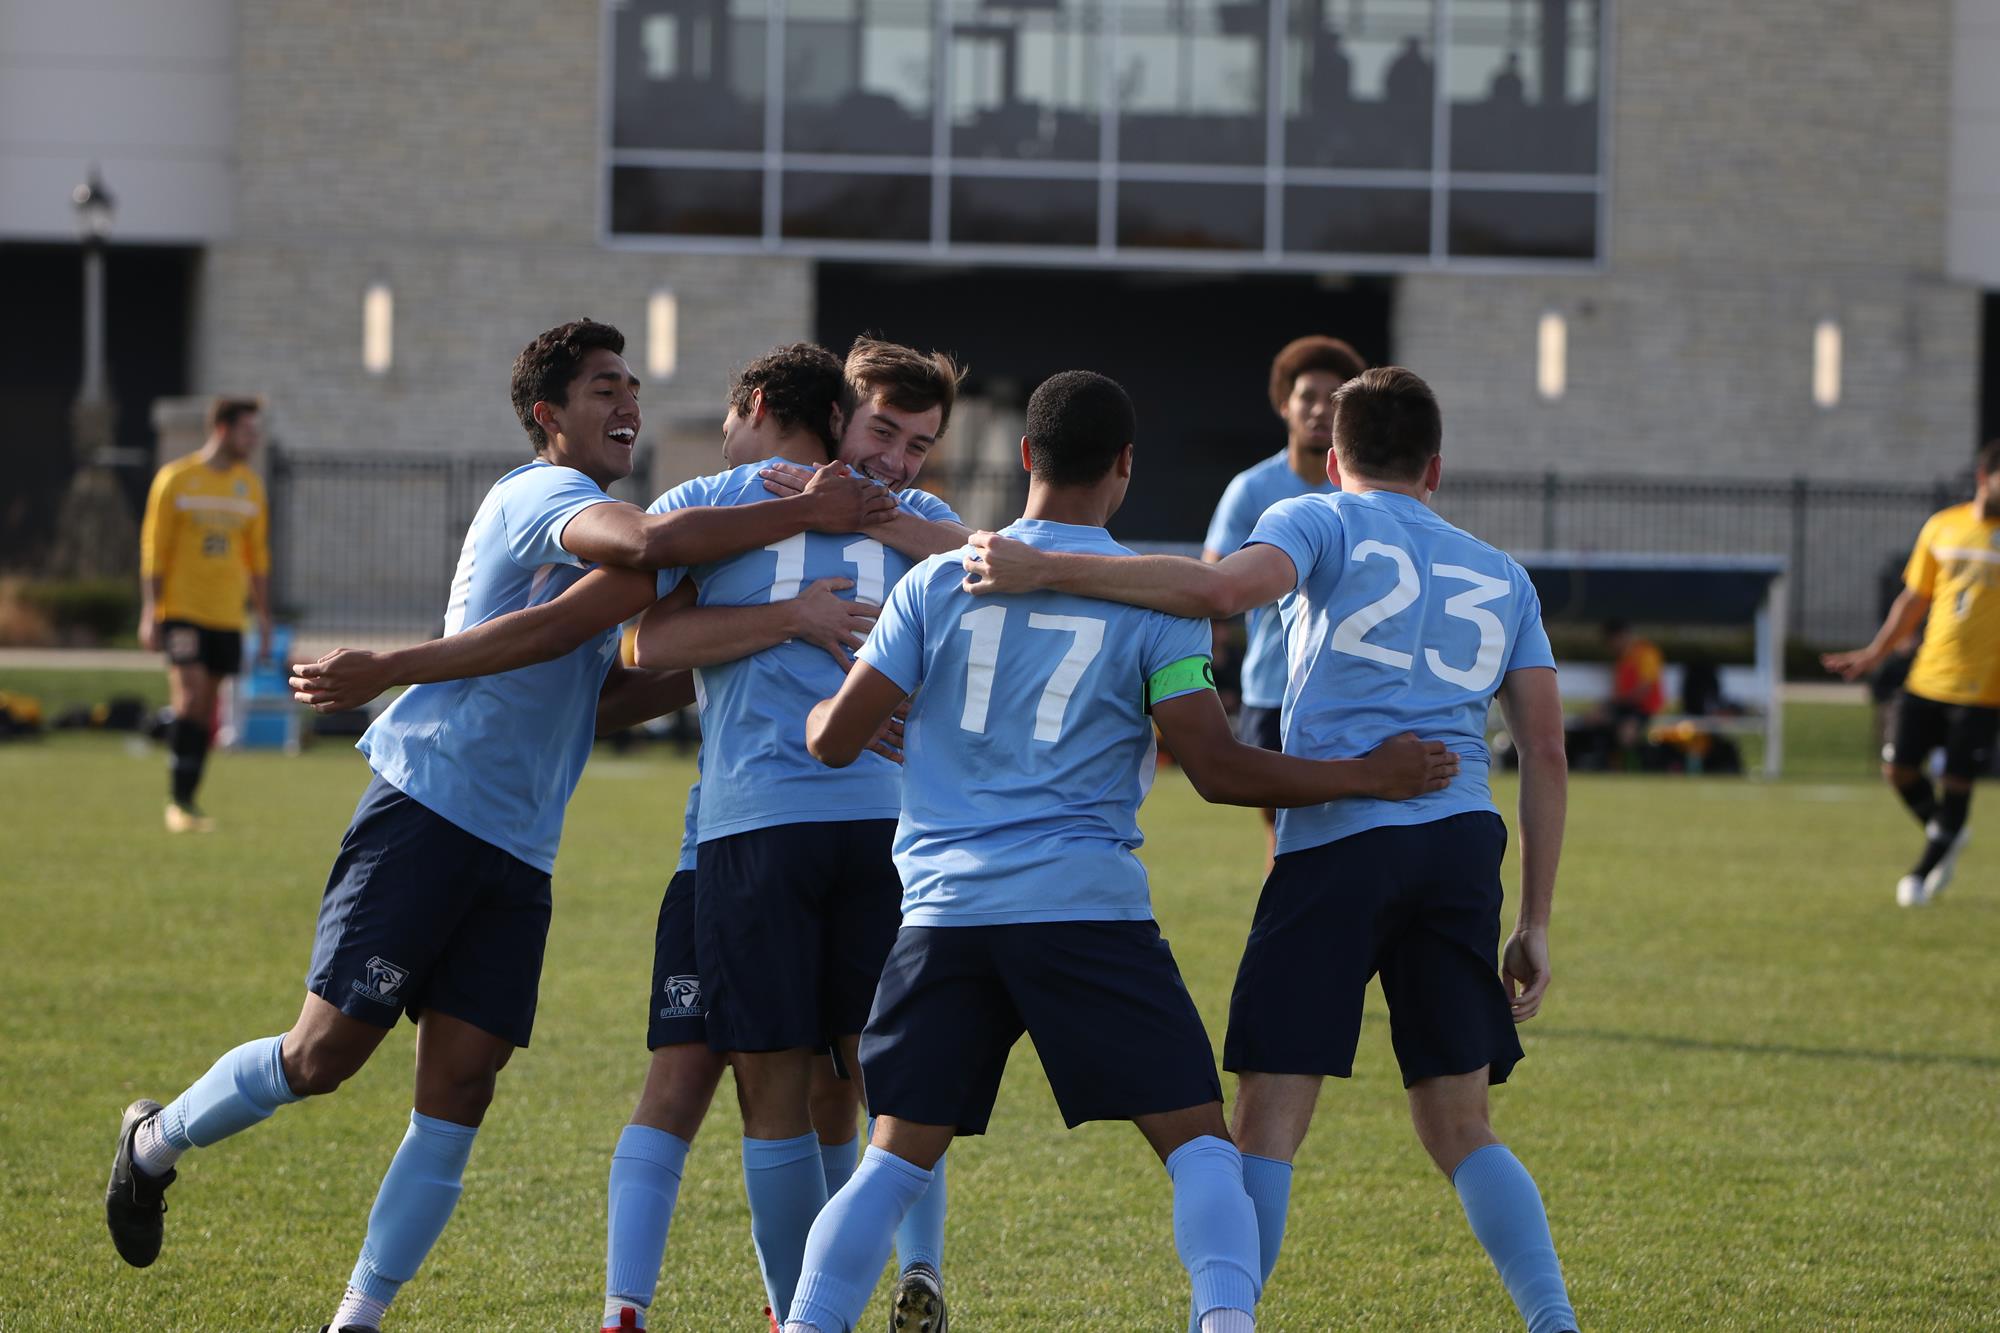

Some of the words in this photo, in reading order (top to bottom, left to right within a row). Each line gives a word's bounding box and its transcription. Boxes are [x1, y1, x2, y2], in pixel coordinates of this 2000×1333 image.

[764, 531, 886, 622] 11
[1331, 539, 1511, 692] 23
[959, 605, 1106, 742] 17
